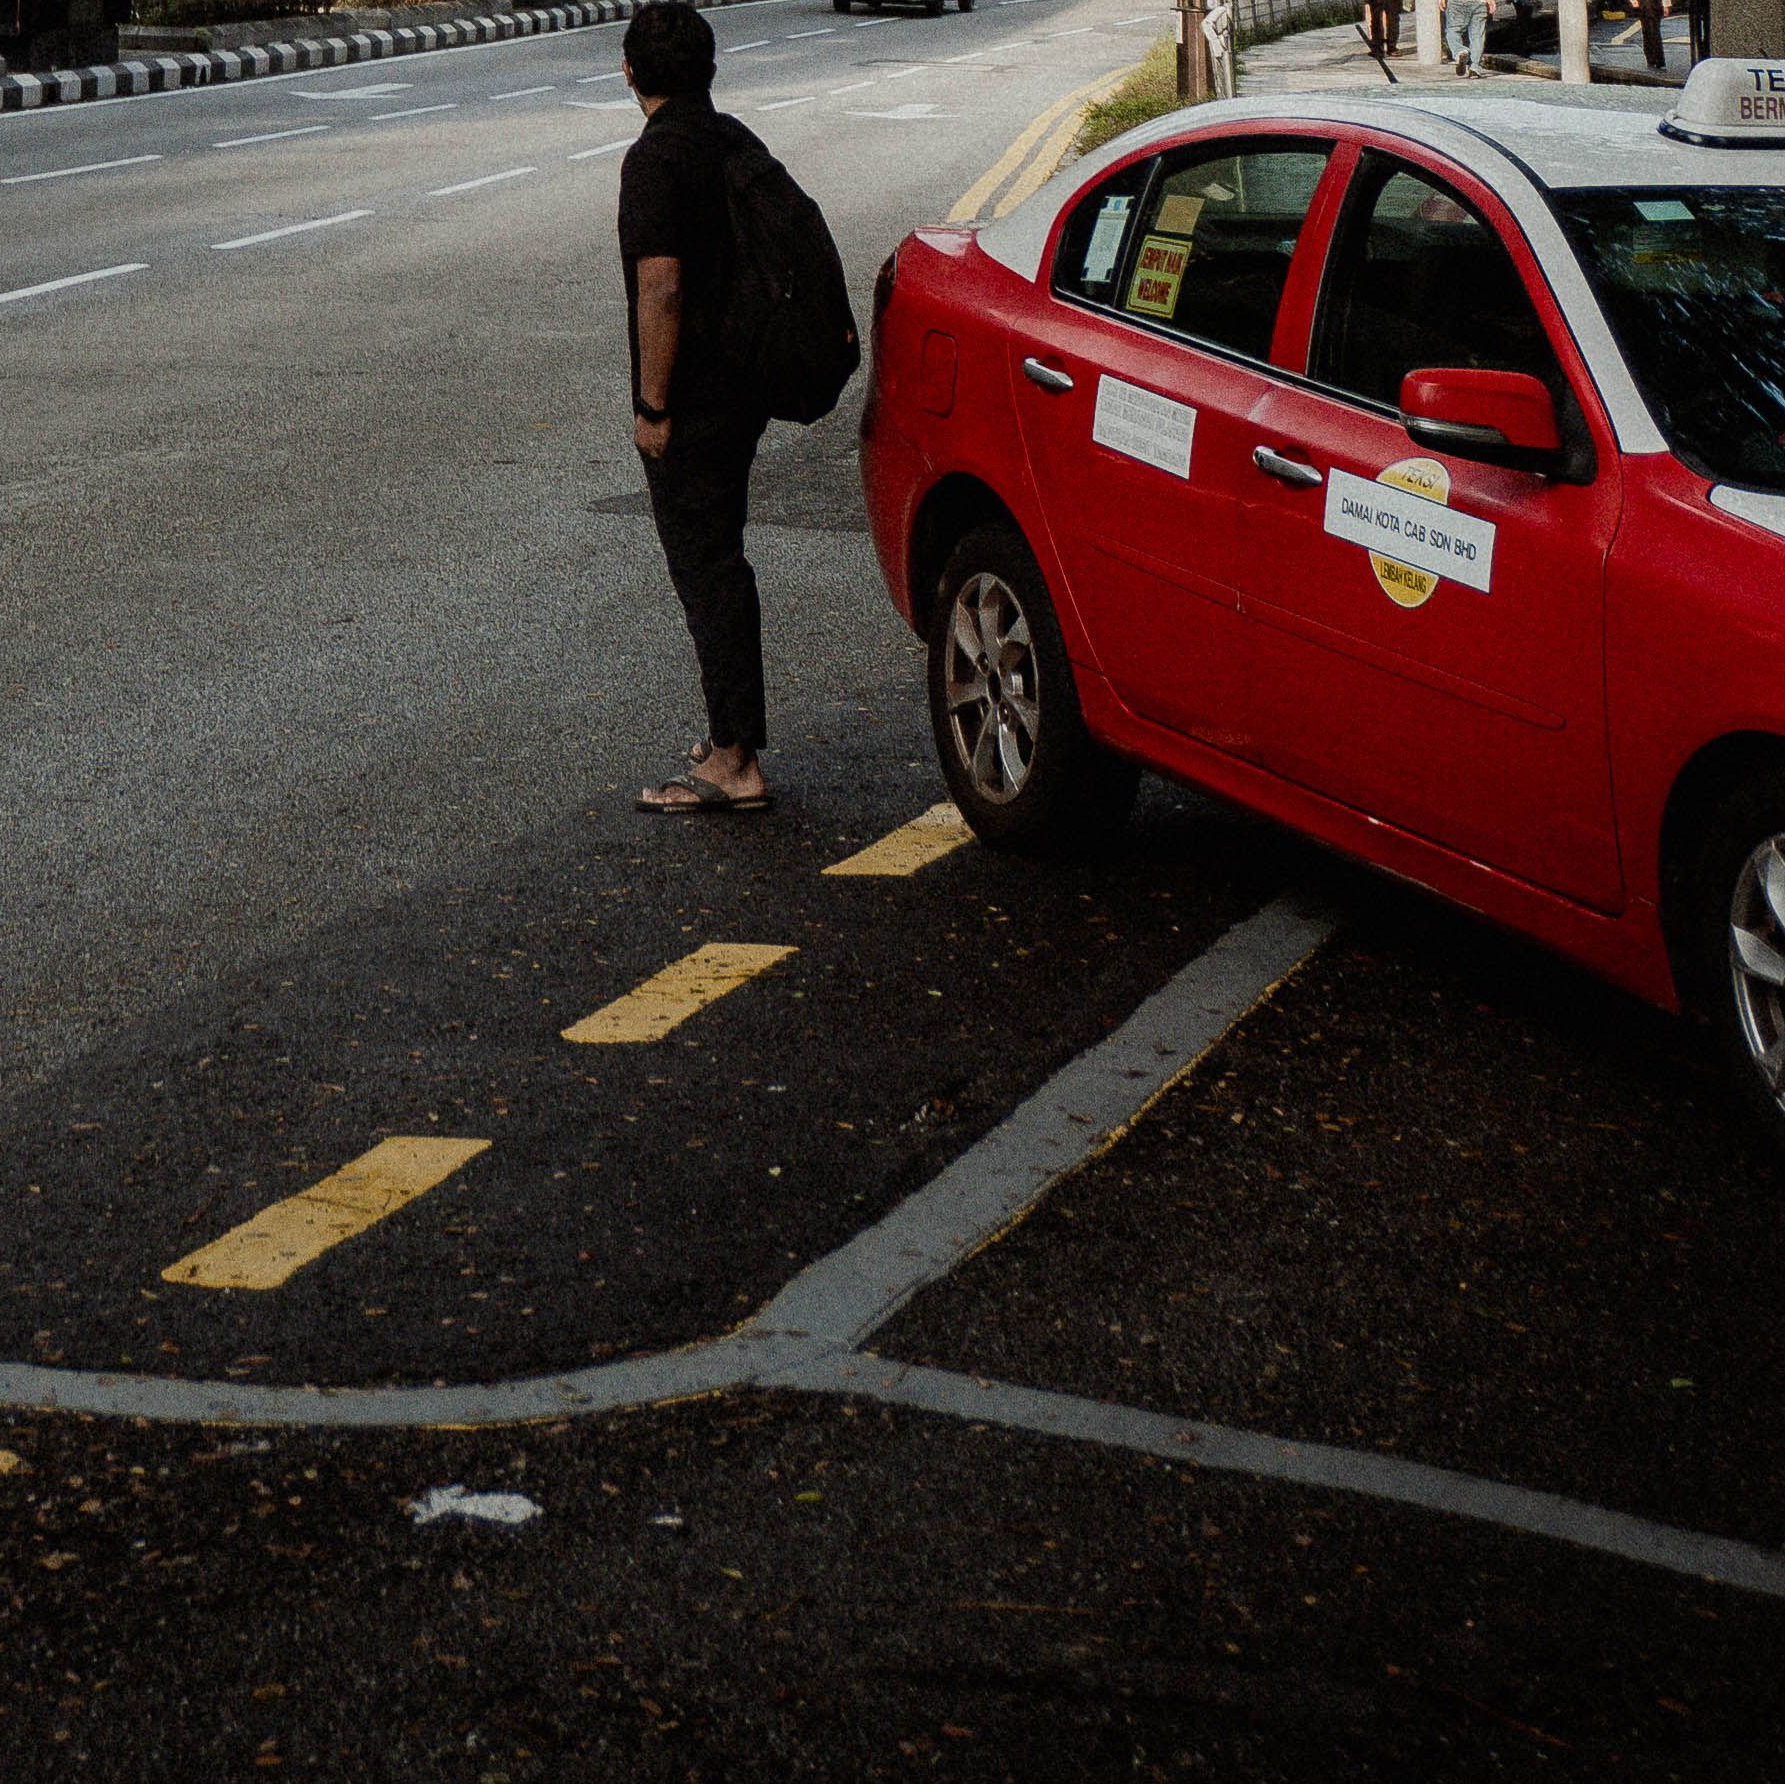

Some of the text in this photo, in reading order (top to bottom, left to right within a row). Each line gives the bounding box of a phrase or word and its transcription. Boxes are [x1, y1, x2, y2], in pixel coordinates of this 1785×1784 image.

[1401, 465, 1440, 489] TEKSI
[1341, 497, 1478, 561] DAMAI KOTA CAB SDN BHD
[1403, 569, 1427, 594] KELANG
